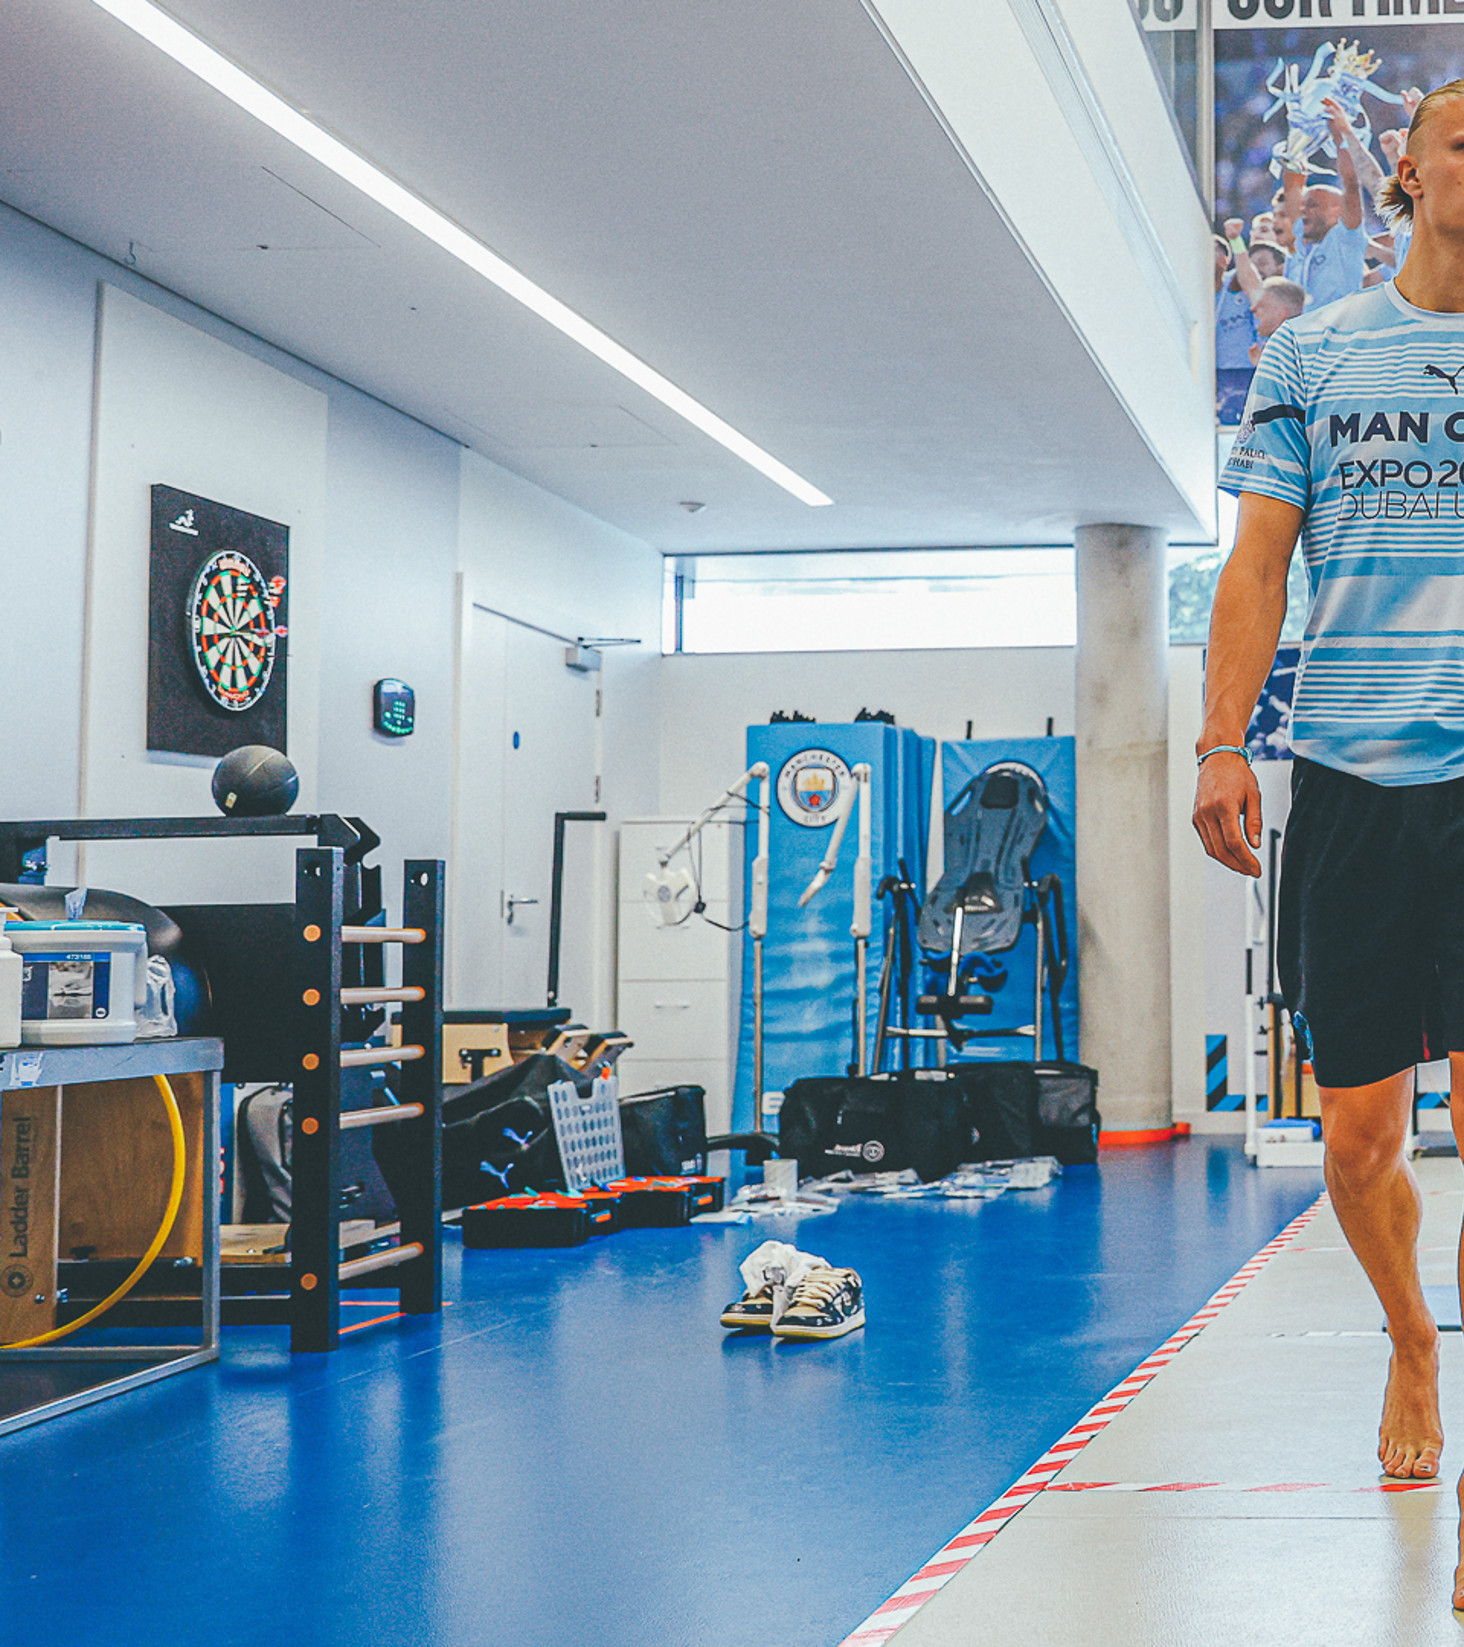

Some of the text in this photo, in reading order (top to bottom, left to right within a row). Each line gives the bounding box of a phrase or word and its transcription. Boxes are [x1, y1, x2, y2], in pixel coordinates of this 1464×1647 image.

[1328, 411, 1430, 448] MAN
[1338, 458, 1433, 490] EXPO
[1336, 490, 1440, 522] DUBAI
[11, 1116, 32, 1179] Barrel
[8, 1185, 30, 1258] Ladder
